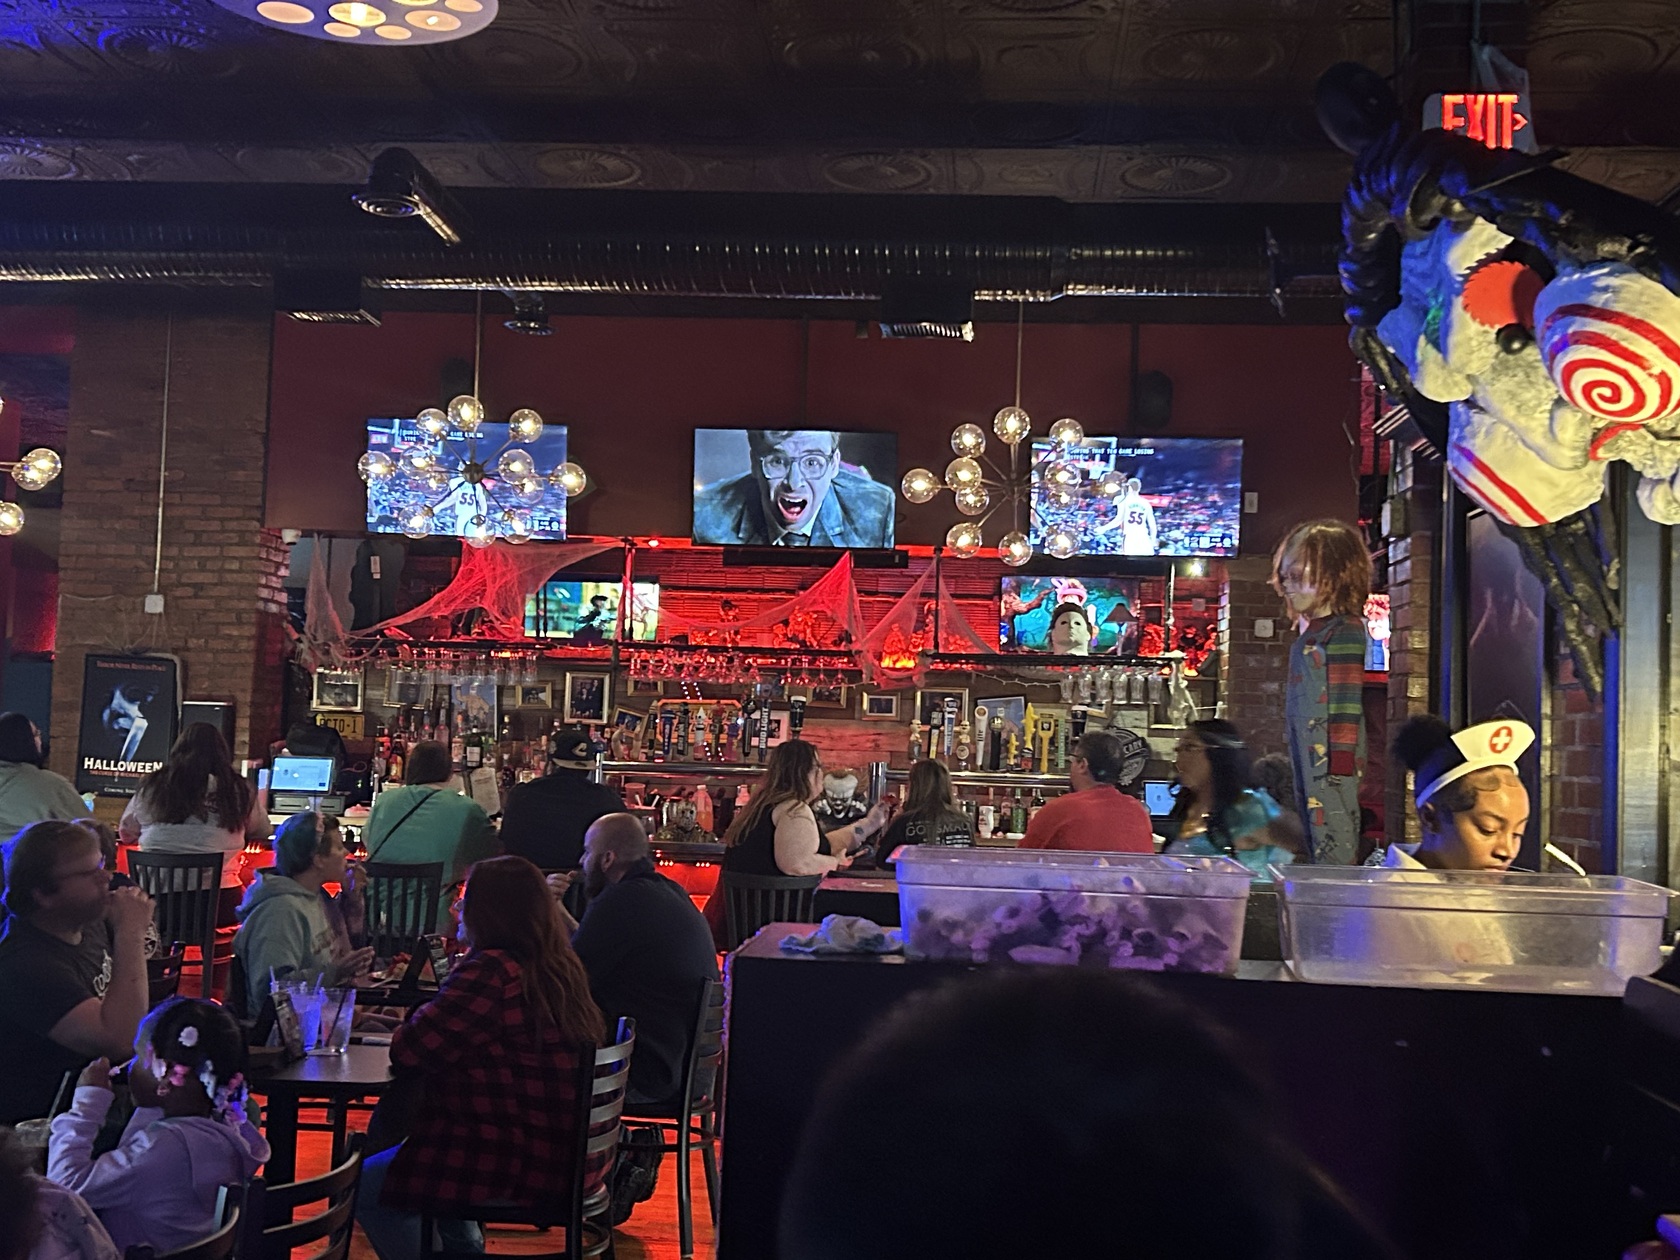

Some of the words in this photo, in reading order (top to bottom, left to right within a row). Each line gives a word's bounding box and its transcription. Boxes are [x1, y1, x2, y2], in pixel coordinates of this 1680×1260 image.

[1442, 94, 1519, 149] EXIT
[1128, 511, 1144, 525] 55
[760, 707, 769, 731] LIGHT
[759, 731, 767, 749] BUD
[83, 757, 163, 773] HALLOWEEN
